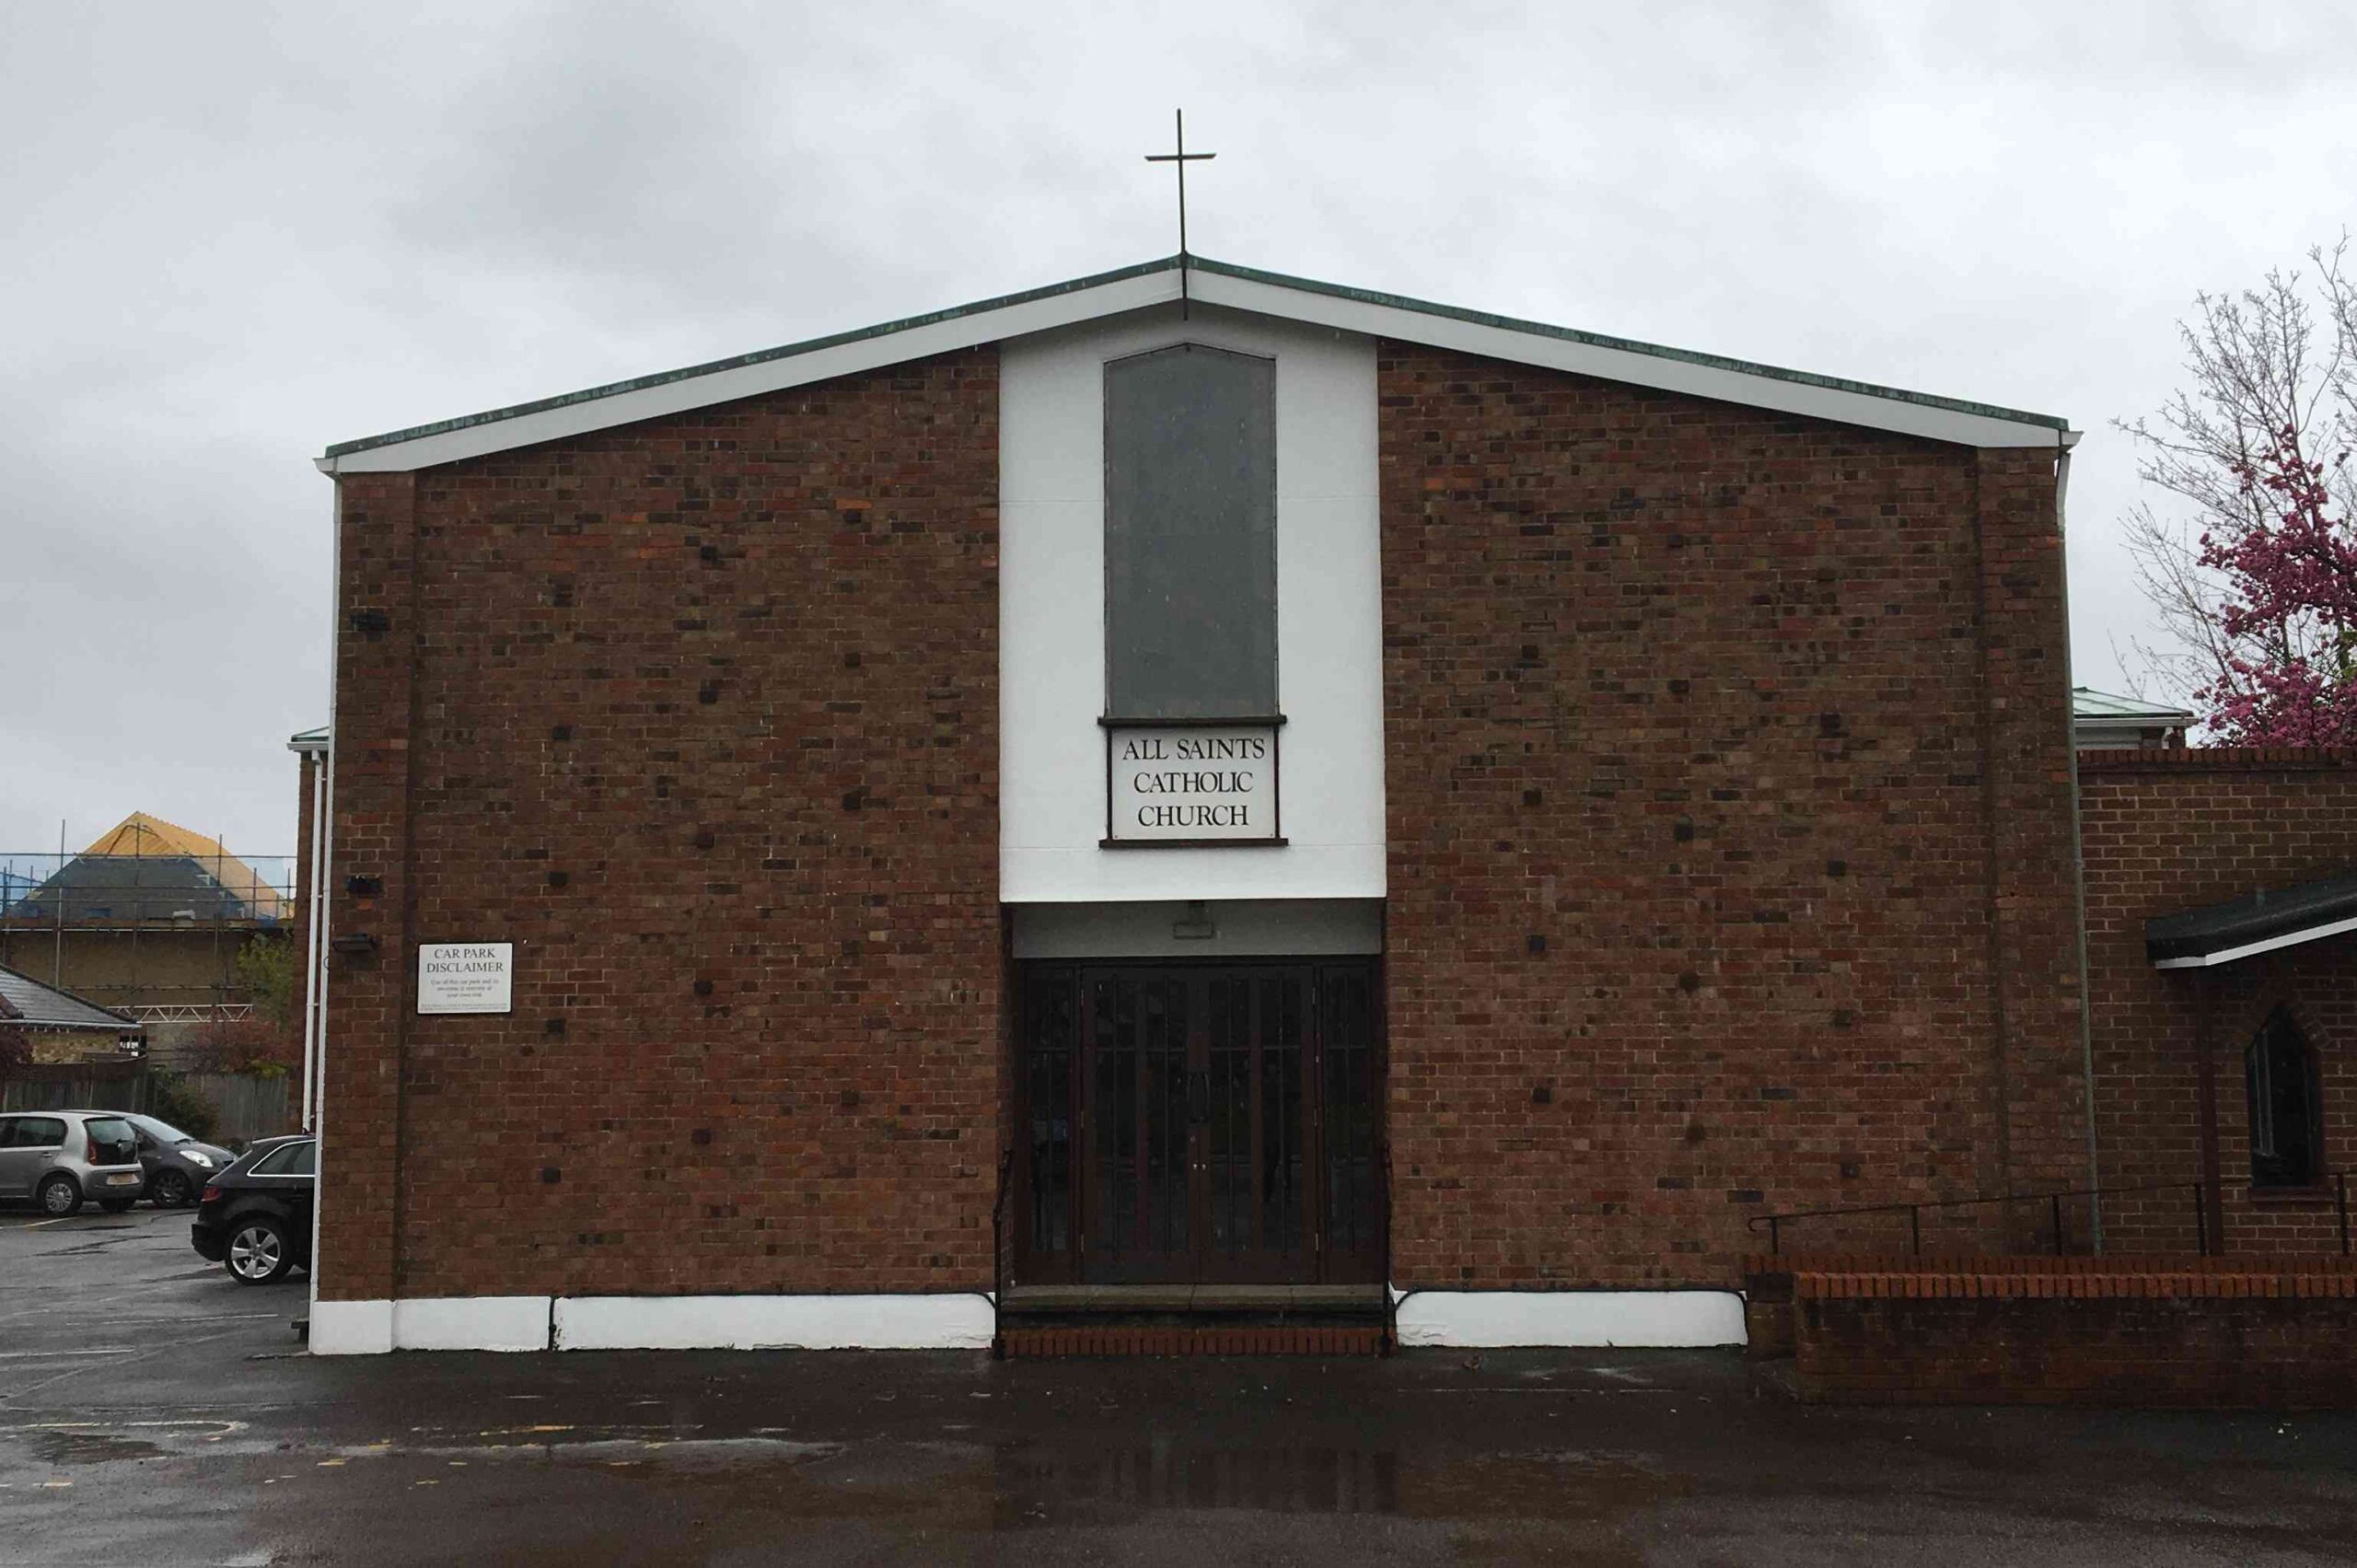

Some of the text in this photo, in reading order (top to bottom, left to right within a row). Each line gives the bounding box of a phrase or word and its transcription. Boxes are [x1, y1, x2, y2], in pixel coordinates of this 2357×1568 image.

[1122, 738, 1265, 761] ALL SAINTS
[1133, 772, 1253, 794] CATHOLIC
[1138, 805, 1249, 827] CHURCH
[434, 947, 495, 959] CAR PARK
[426, 962, 504, 973] DISCLAIMER
